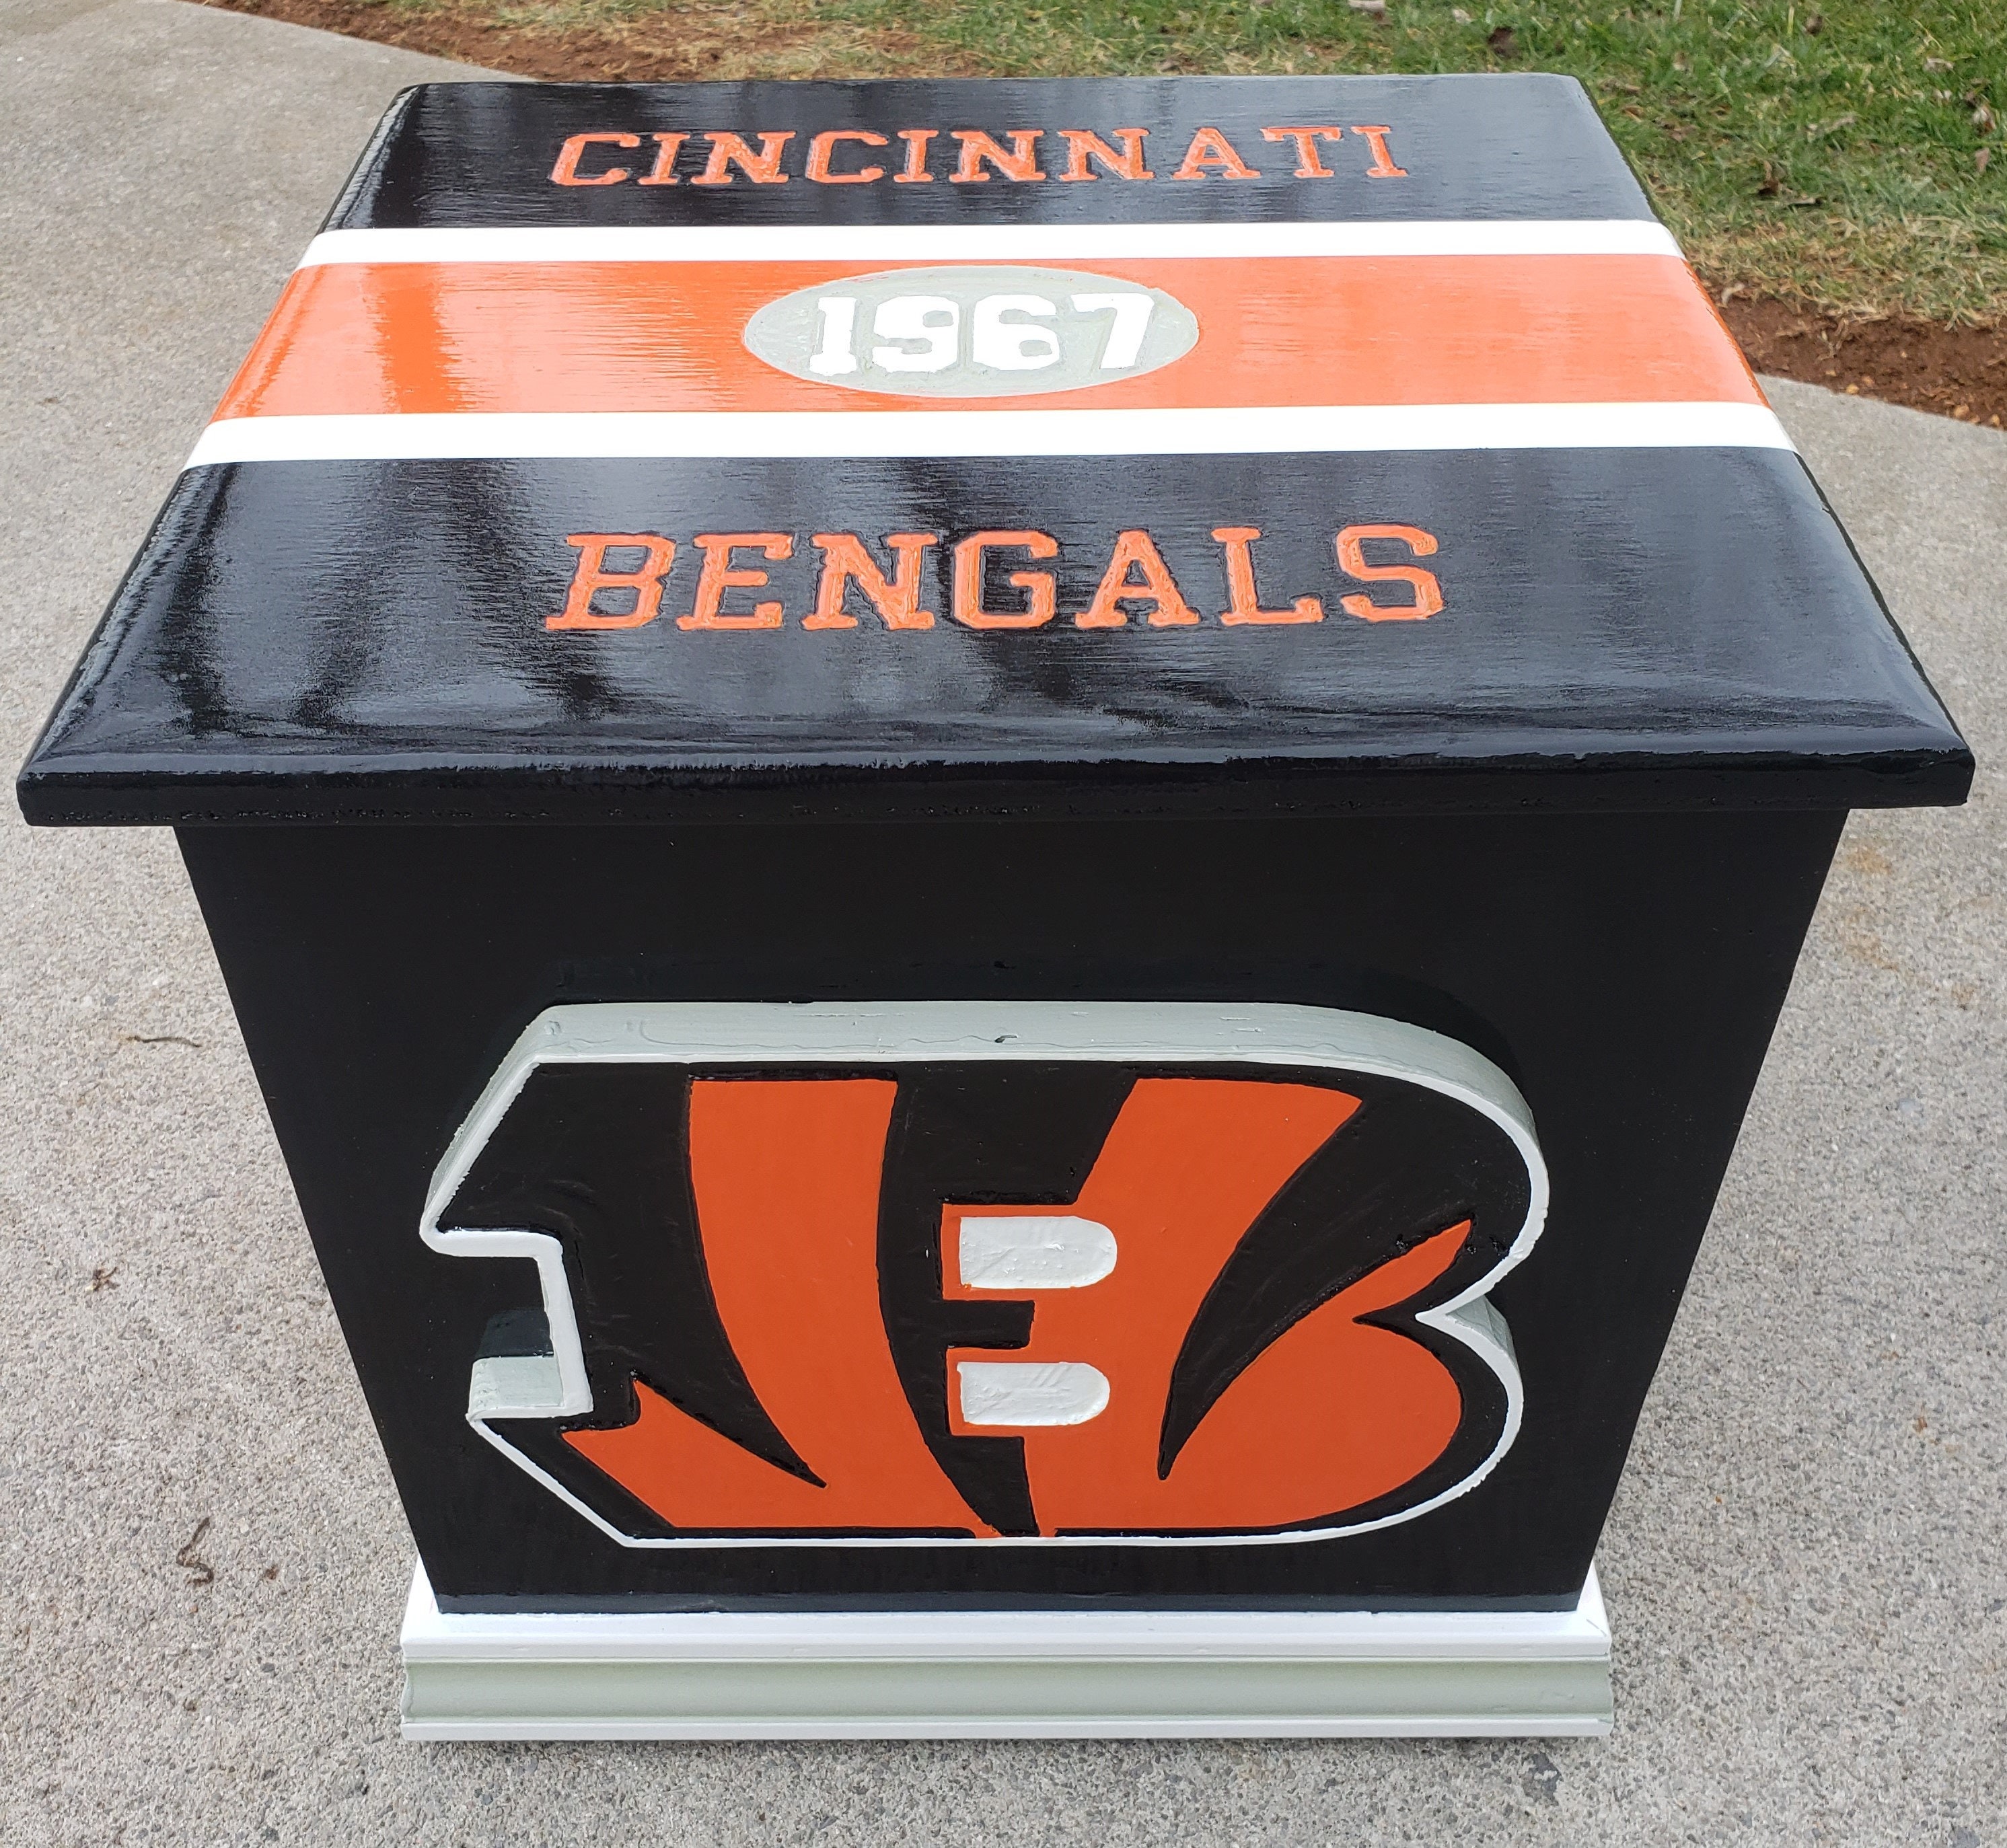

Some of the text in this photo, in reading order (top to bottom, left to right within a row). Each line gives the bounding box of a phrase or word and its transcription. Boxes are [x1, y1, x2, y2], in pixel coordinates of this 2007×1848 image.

[551, 124, 1409, 187] CINCINNATI
[807, 292, 1155, 377] 1967
[546, 524, 1445, 631] BENGALS
